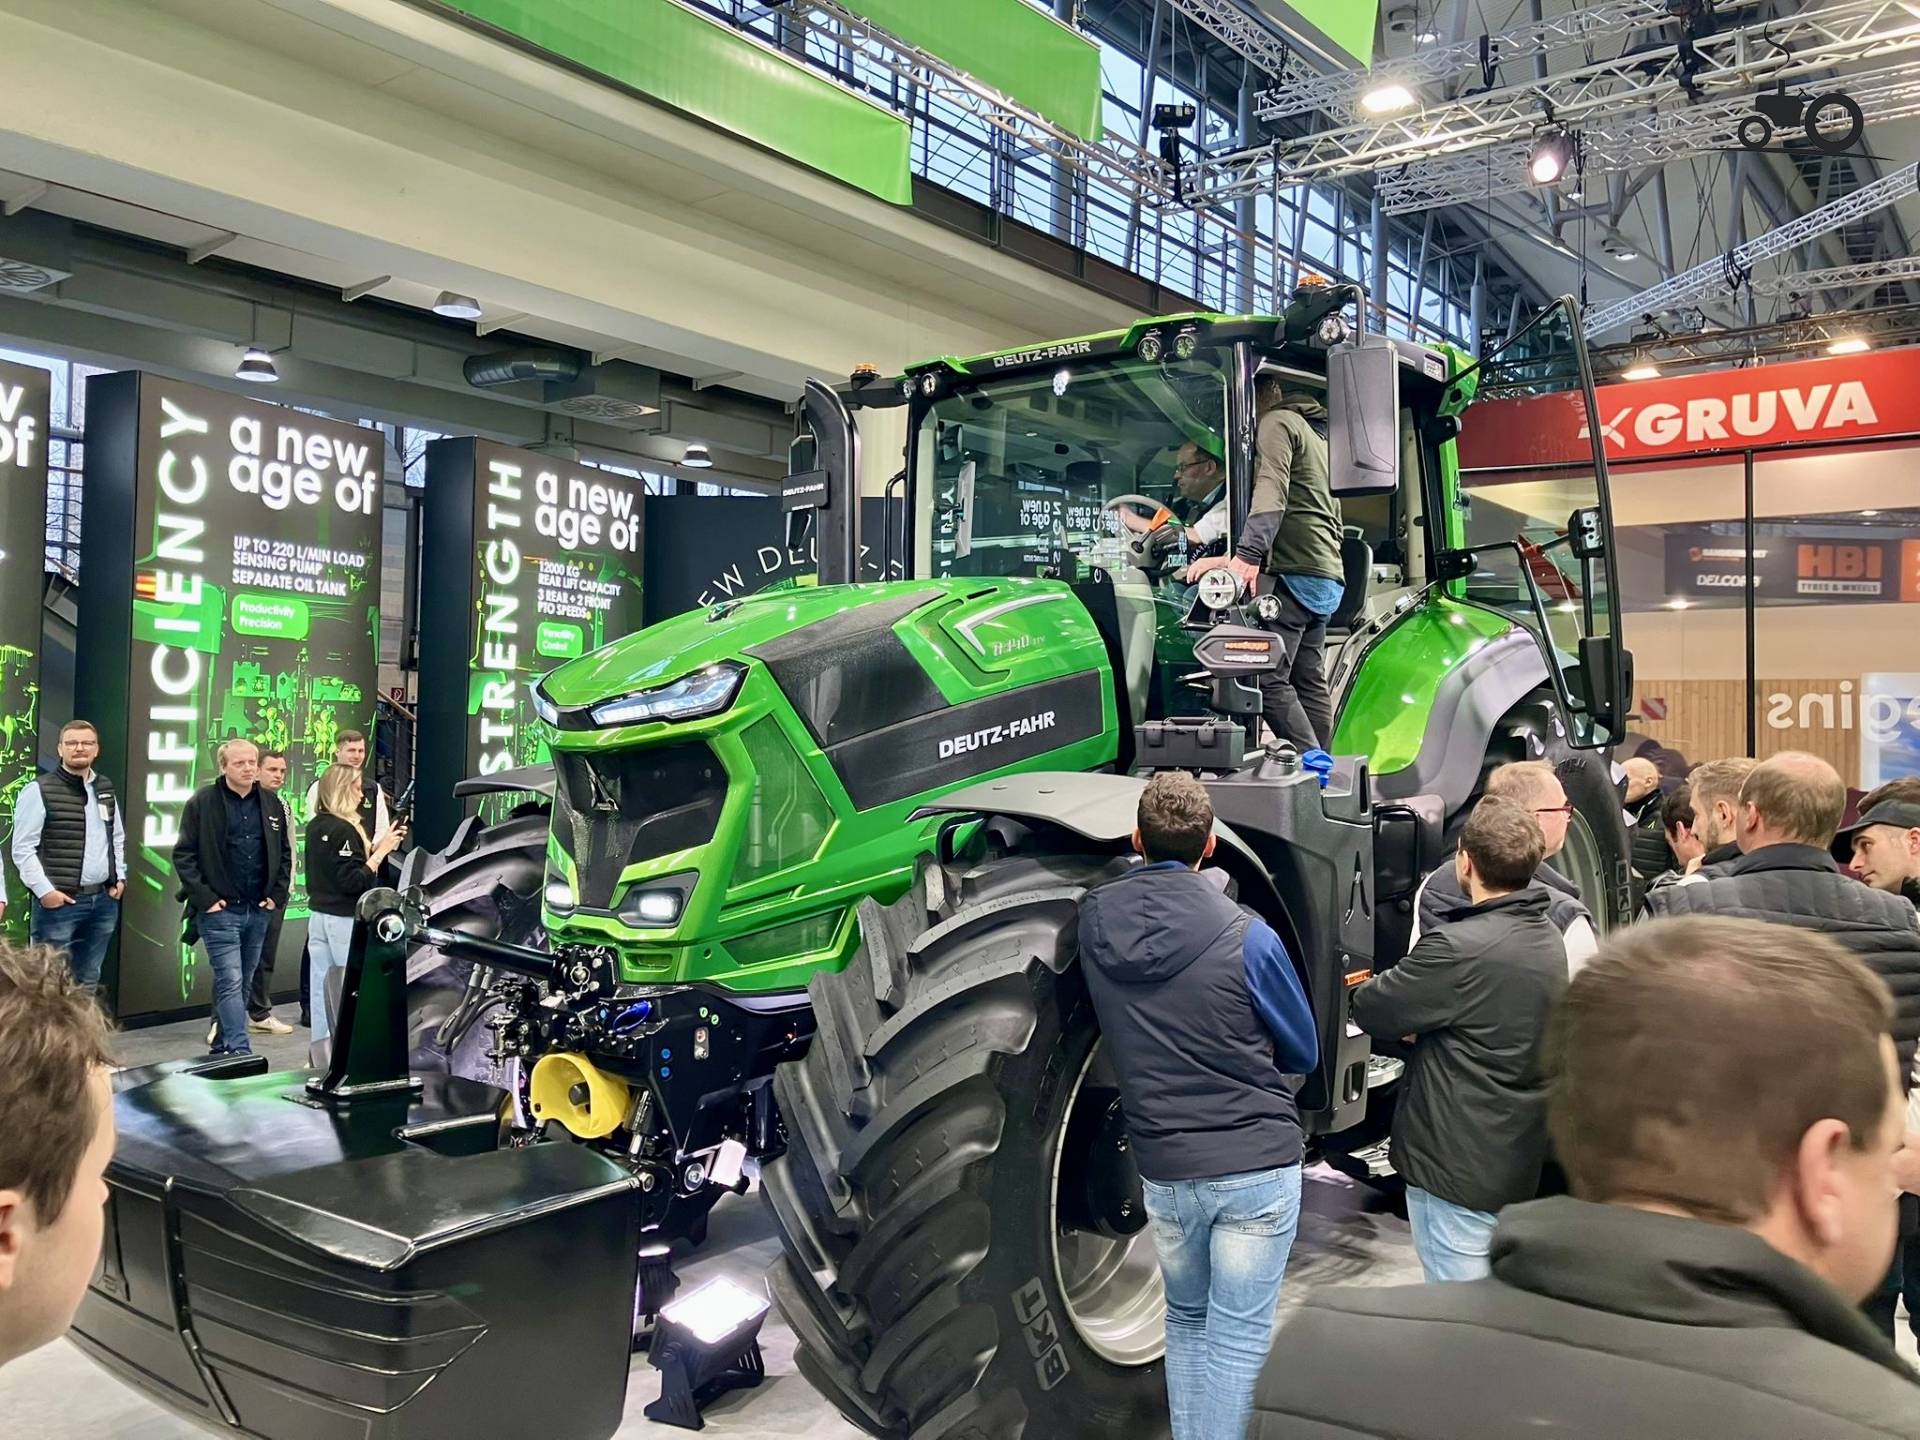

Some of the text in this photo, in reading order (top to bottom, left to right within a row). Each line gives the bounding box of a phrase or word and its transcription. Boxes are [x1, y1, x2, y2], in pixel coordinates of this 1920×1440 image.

[993, 341, 1091, 368] DEUTZ-FAHR
[1634, 381, 1878, 446] GRUVA
[229, 416, 369, 477] a new
[228, 456, 375, 514] age of
[535, 471, 633, 519] a new
[783, 483, 824, 496] DEUTZ-FAHR
[535, 504, 639, 552] age of
[233, 536, 365, 568] UP TO 220 L/MIN LOAD
[233, 550, 323, 576] SENSING PUMP
[540, 561, 580, 577] 12000 KG
[1797, 543, 1883, 578] HBI
[232, 569, 347, 597] SEPARATE OIL TANK
[537, 588, 544, 601] 3
[545, 590, 568, 604] REAR
[577, 594, 583, 606] 2
[584, 595, 612, 610] FRONT
[538, 573, 621, 596] REAR LIFT CAPACITY
[143, 396, 209, 847] EFFICIENCY
[480, 460, 522, 776] STRENGTH
[537, 601, 587, 618] PTO SPEEDS
[938, 709, 1055, 760] DEUTZ-FAHR
[1013, 1278, 1070, 1390] BKT
